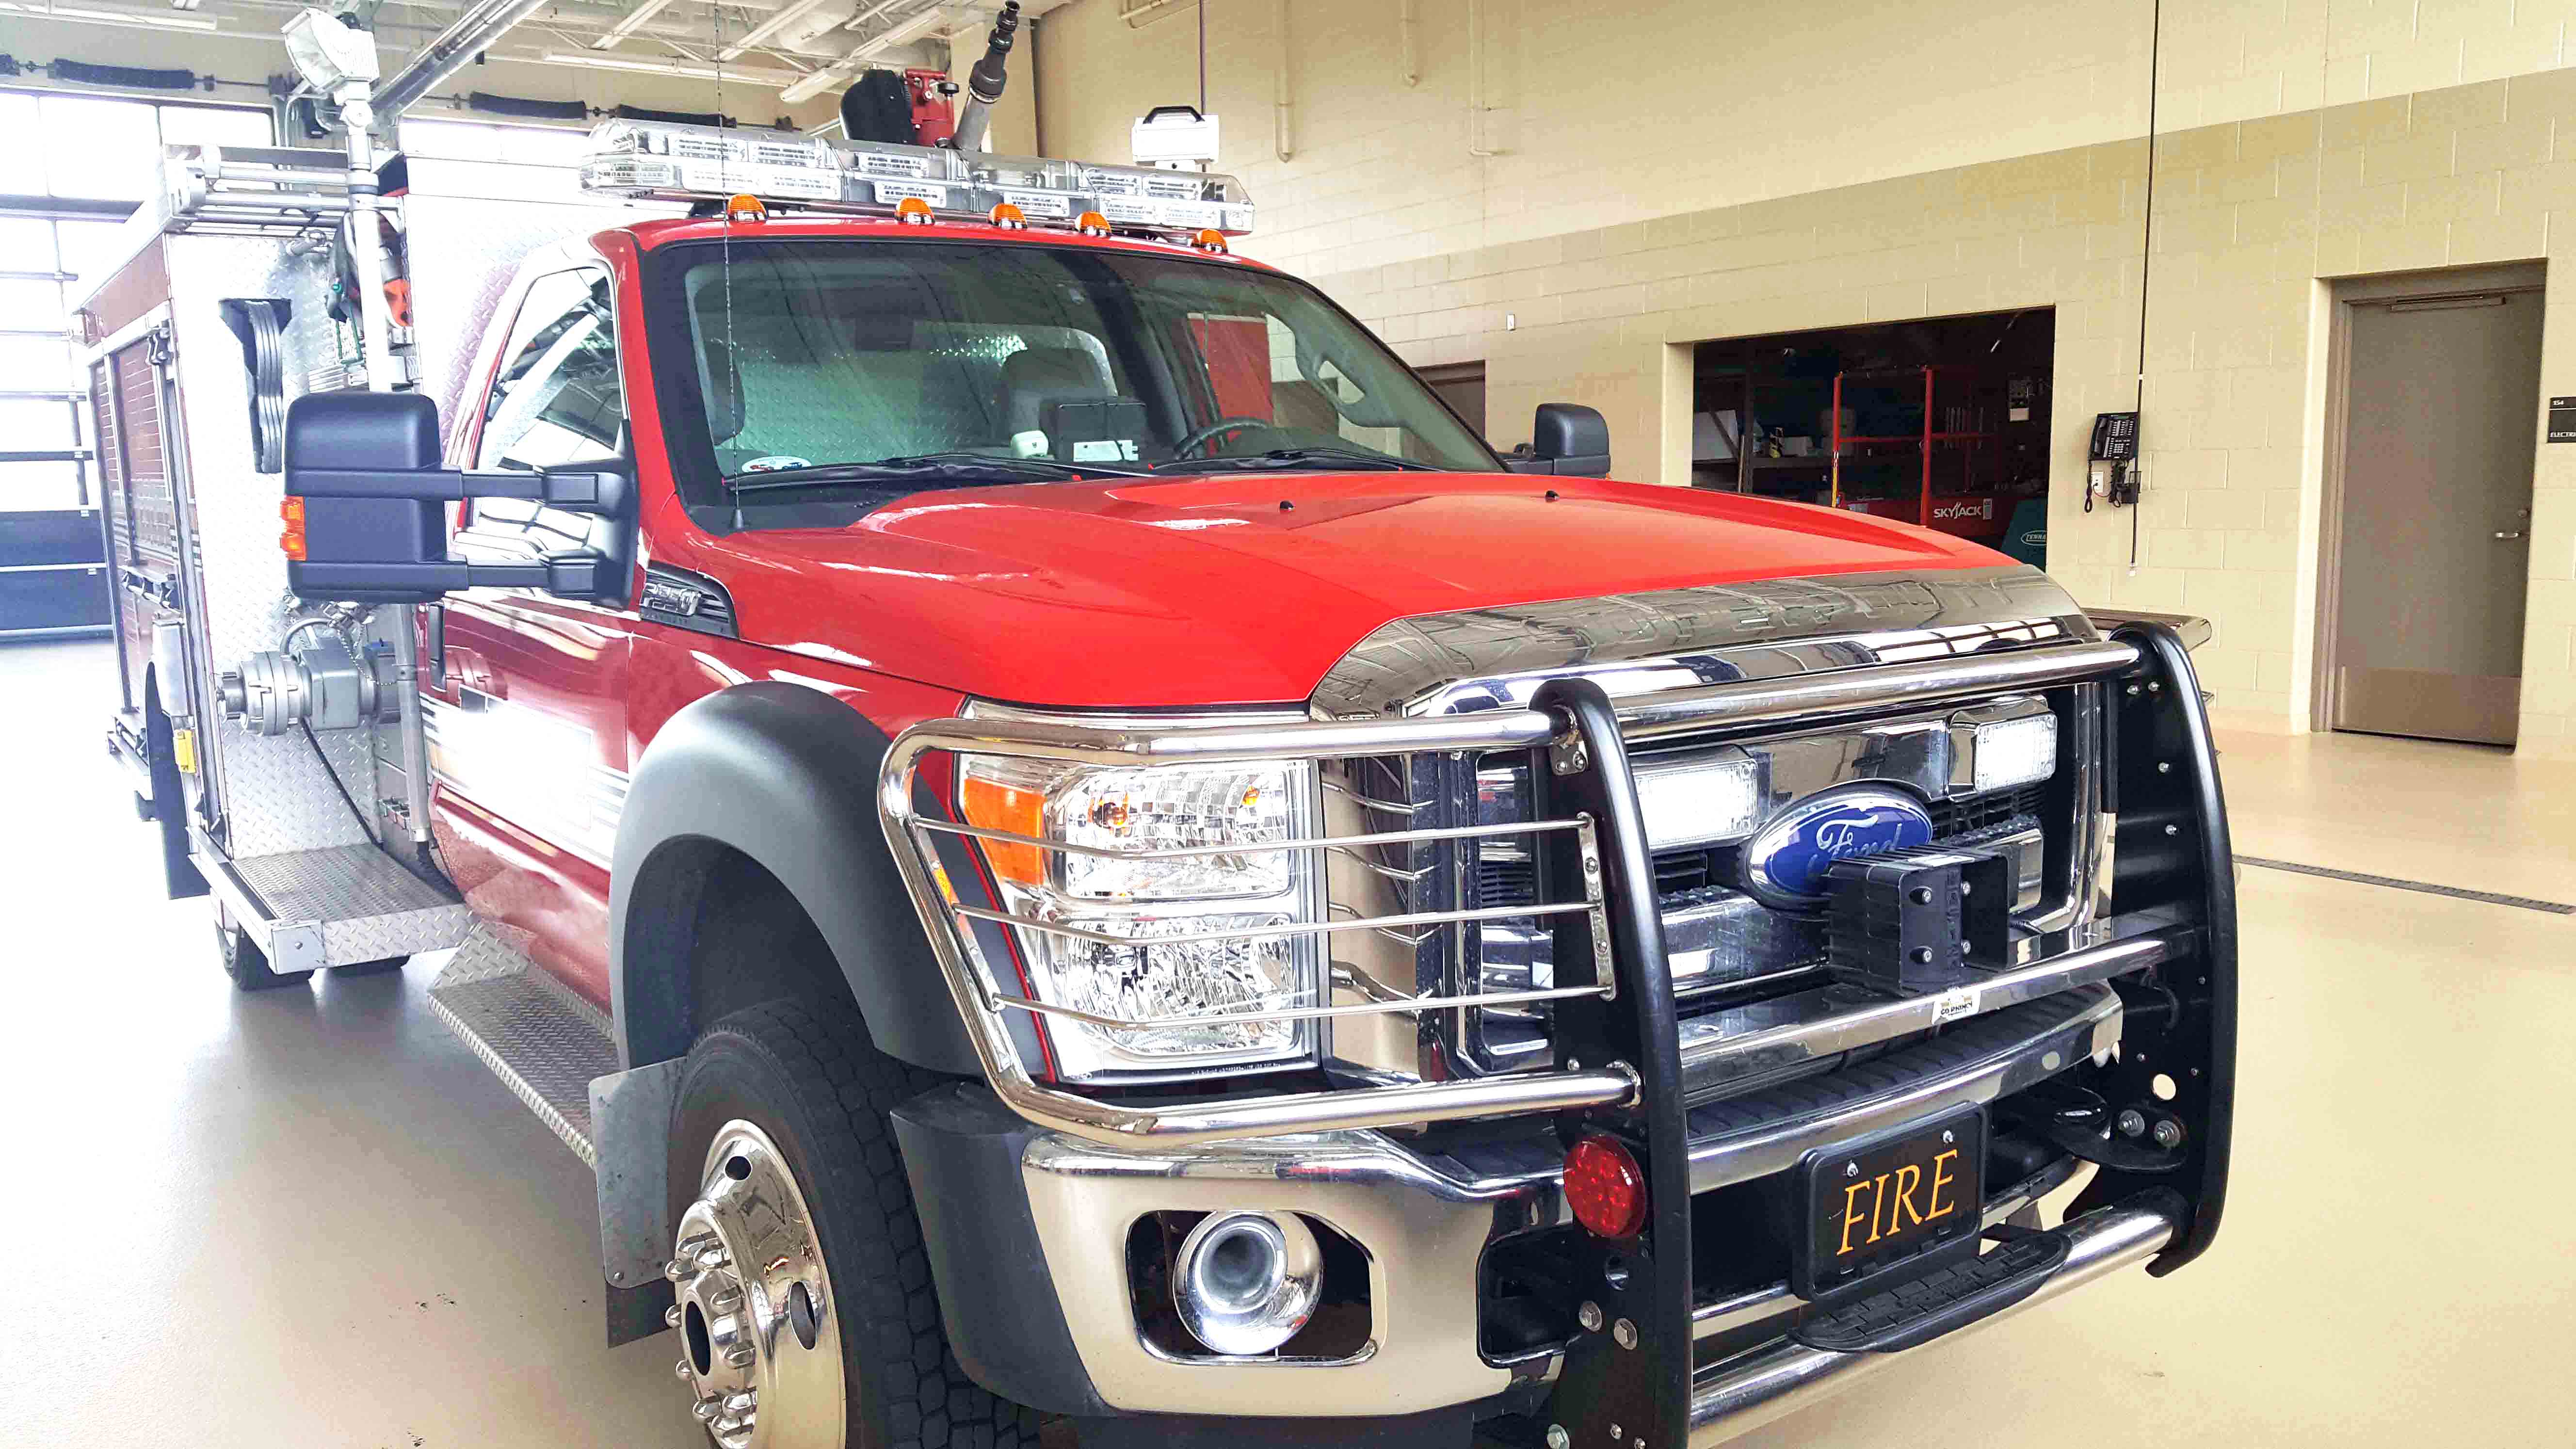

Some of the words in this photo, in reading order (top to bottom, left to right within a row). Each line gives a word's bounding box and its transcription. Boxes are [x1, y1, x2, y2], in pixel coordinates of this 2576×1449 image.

[1933, 501, 1982, 519] SKYJACK
[1807, 814, 1903, 873] Ford
[1836, 1149, 1958, 1256] FIRE
